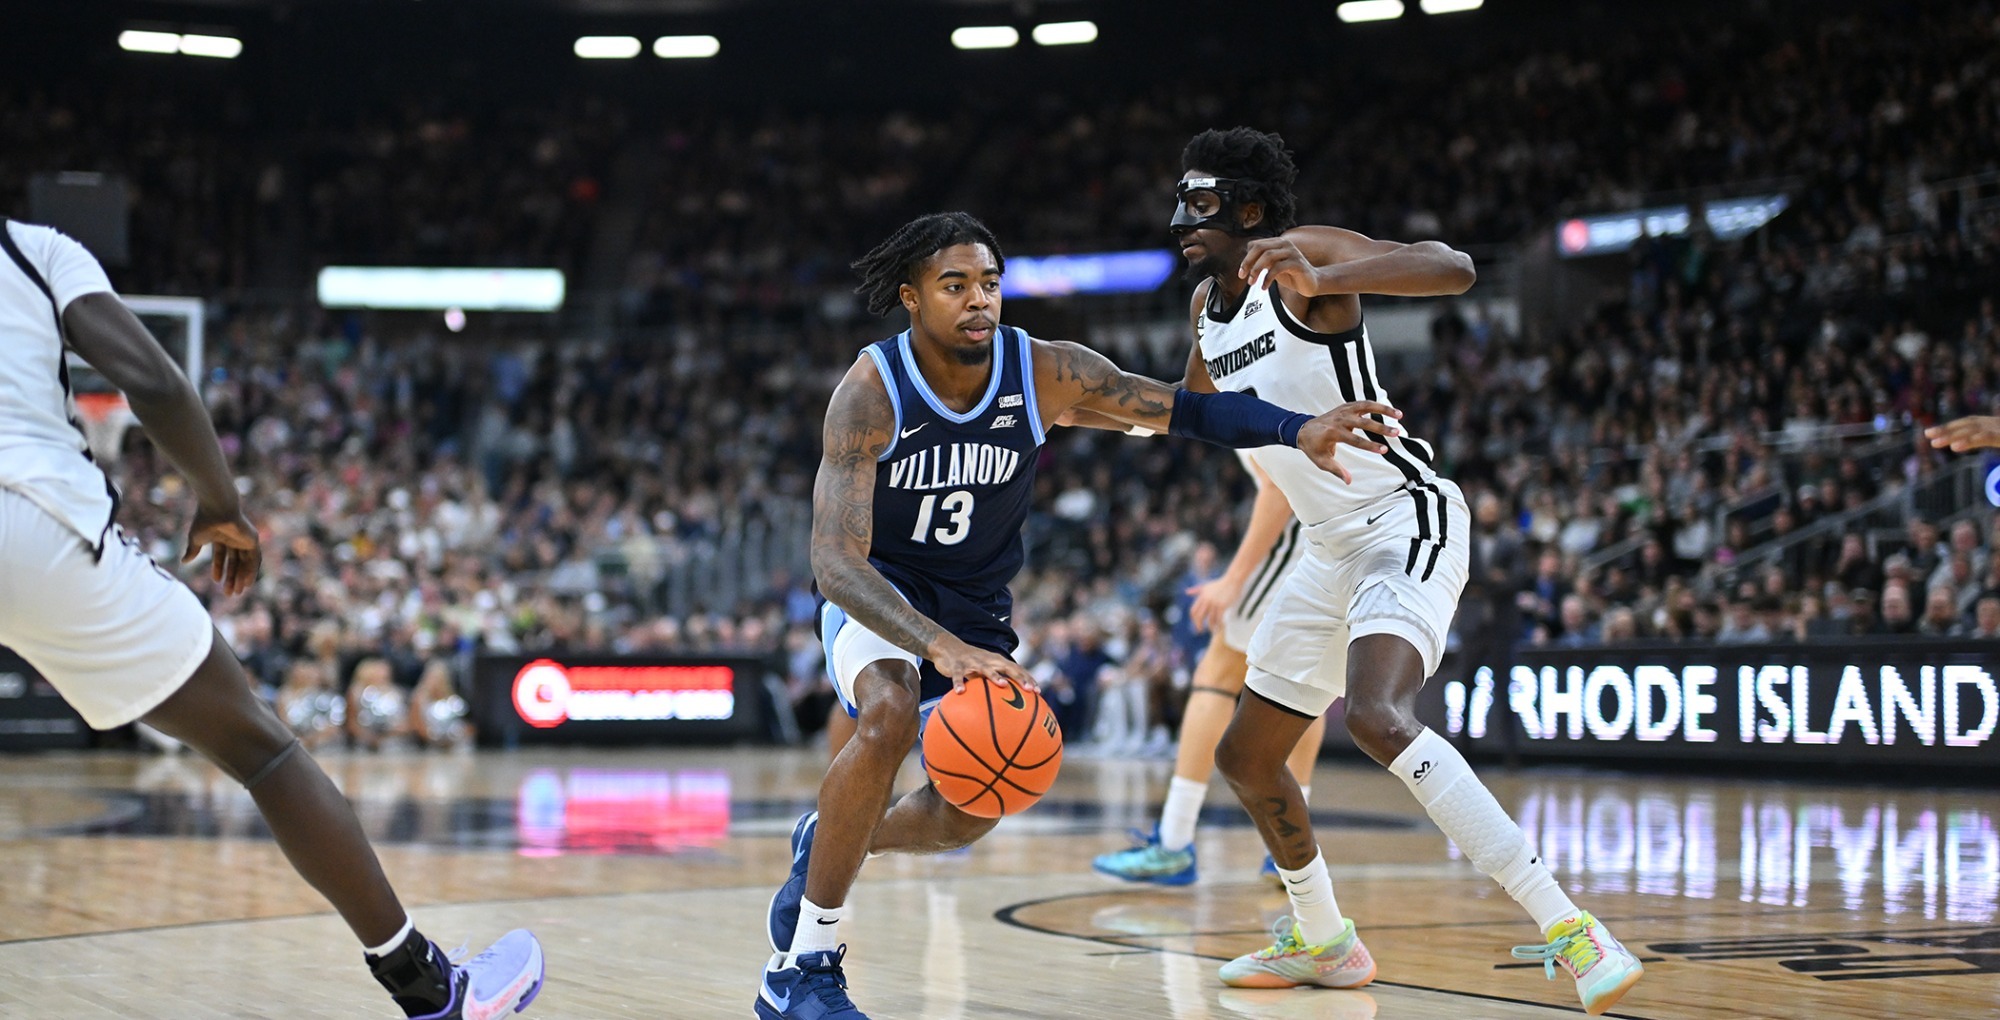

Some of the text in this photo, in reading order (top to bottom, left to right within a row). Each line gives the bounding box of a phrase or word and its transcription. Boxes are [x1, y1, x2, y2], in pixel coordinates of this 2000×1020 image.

[888, 442, 1020, 490] VILLANOVA
[910, 490, 975, 546] 13
[1508, 665, 1718, 743] RHODE
[1738, 665, 1999, 746] ISLAND
